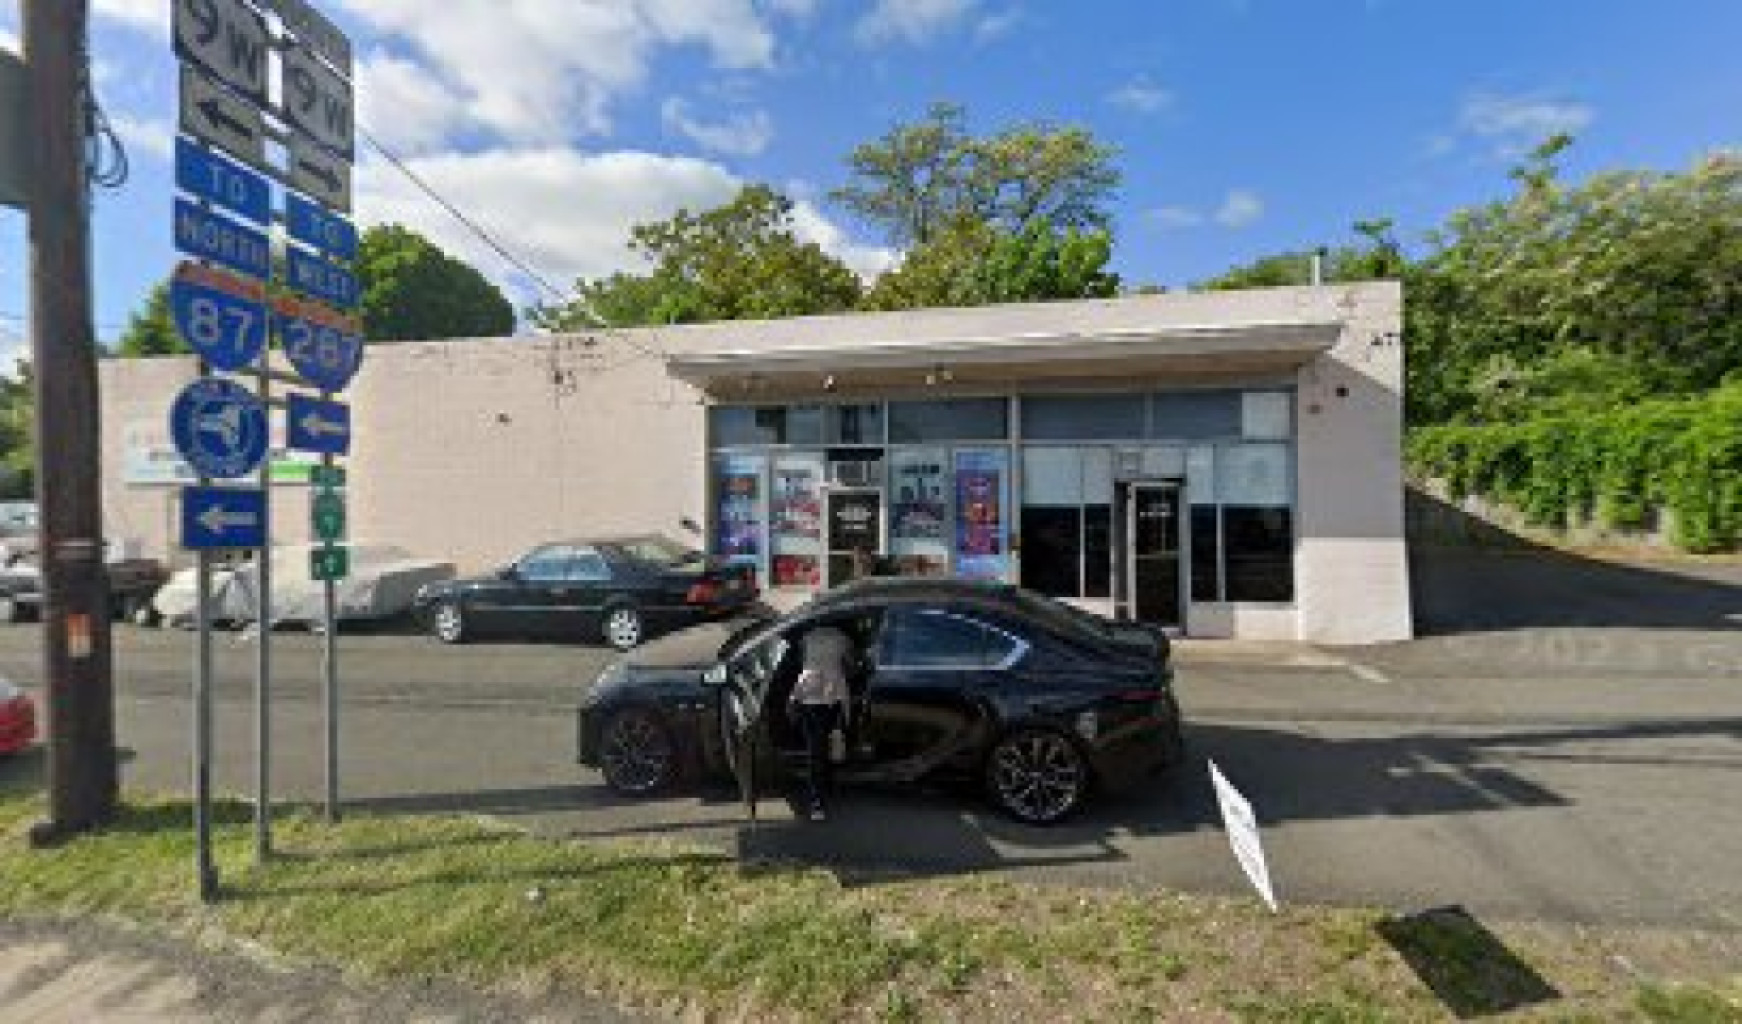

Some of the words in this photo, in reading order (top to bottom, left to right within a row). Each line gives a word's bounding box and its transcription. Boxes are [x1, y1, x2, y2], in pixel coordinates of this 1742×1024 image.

[208, 164, 248, 203] TO
[181, 214, 267, 272] NORTH
[308, 211, 345, 247] TO
[190, 297, 255, 355] 87
[289, 321, 362, 373] 287
